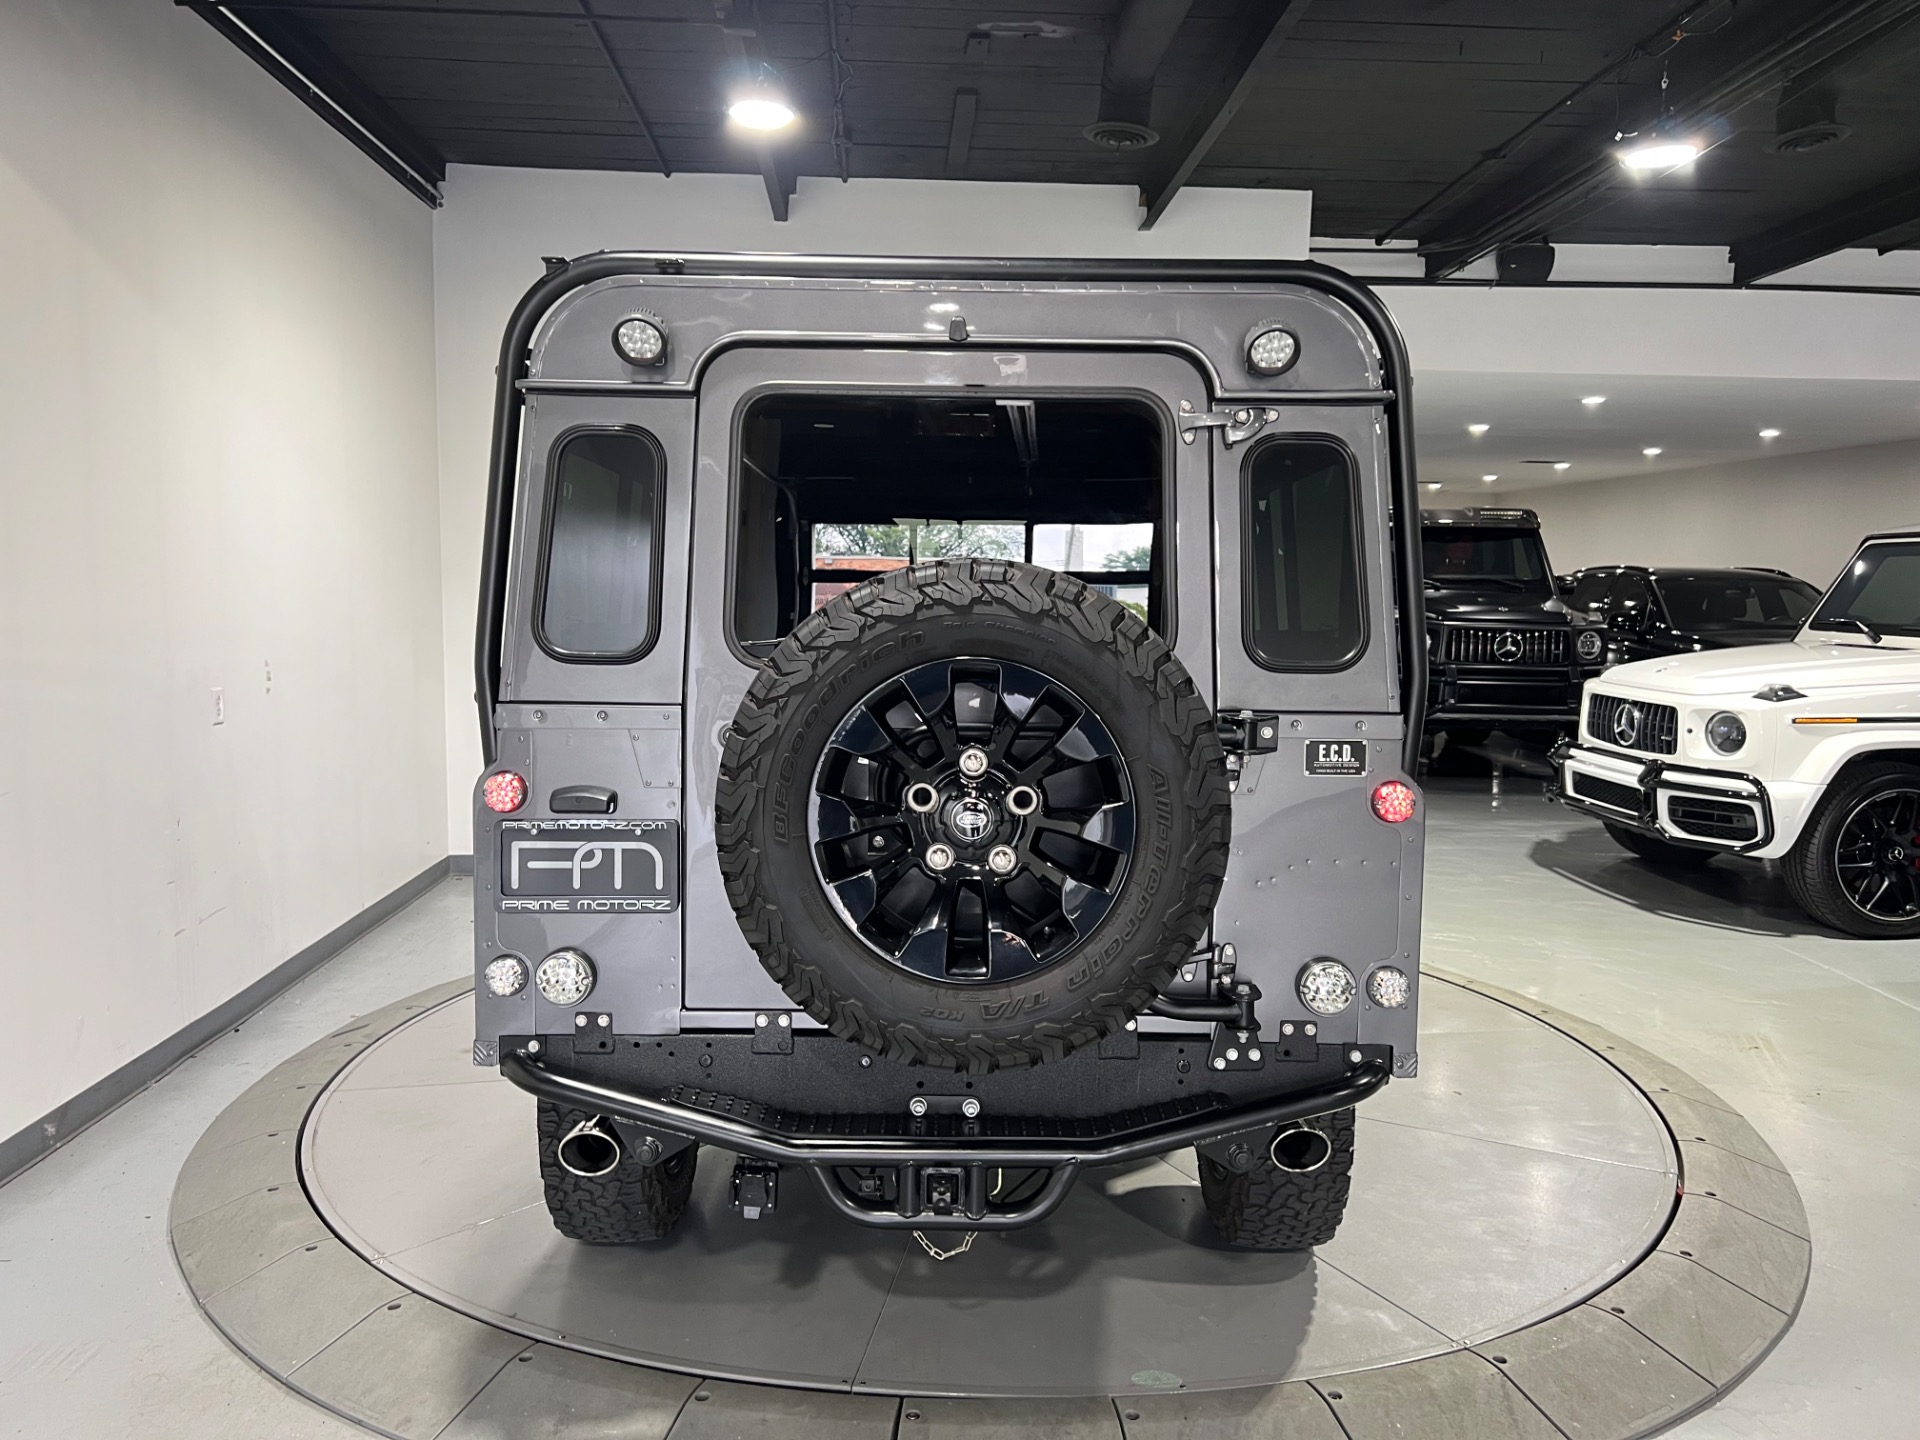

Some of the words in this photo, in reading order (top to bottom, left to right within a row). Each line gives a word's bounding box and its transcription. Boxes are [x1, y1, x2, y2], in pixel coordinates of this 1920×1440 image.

[773, 629, 926, 845] BFGoodrich
[1319, 744, 1355, 762] E.C.D.
[1066, 762, 1175, 990] All-Terrain
[502, 900, 570, 911] PRIME
[577, 900, 671, 911] MOTORZ
[979, 989, 1050, 1022] T/A
